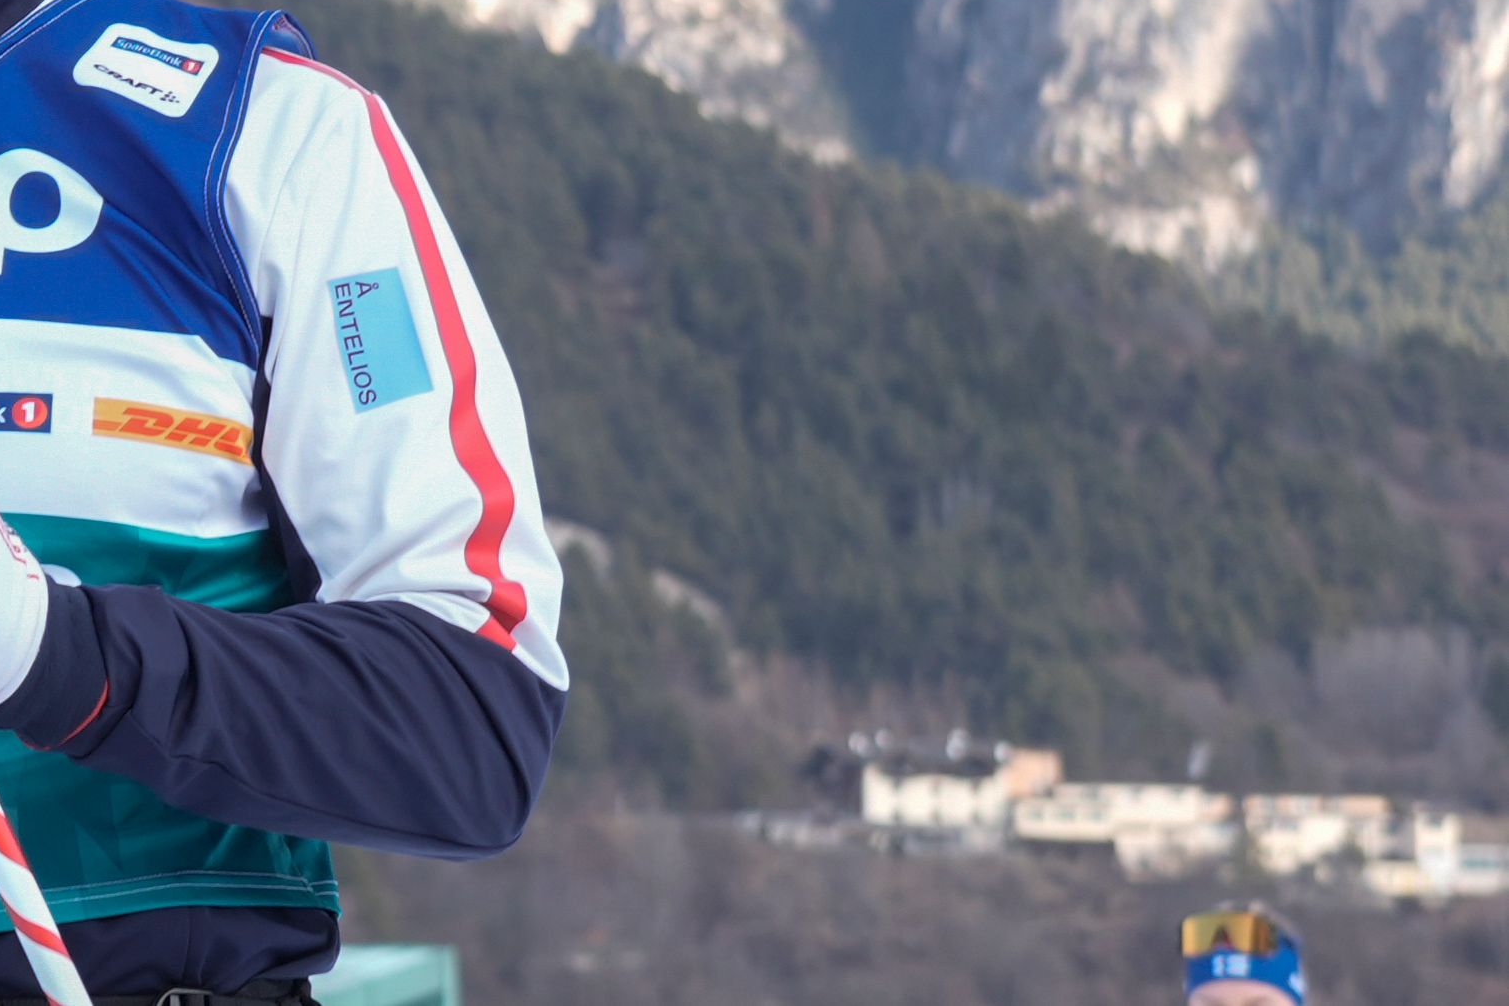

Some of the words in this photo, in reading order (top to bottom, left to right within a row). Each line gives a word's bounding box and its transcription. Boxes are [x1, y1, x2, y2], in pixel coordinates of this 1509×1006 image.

[115, 38, 184, 68] SpareBank
[93, 63, 164, 95] CRAFT
[334, 282, 378, 406] ENTELIOS
[20, 401, 36, 423] 1
[118, 407, 245, 457] DHL
